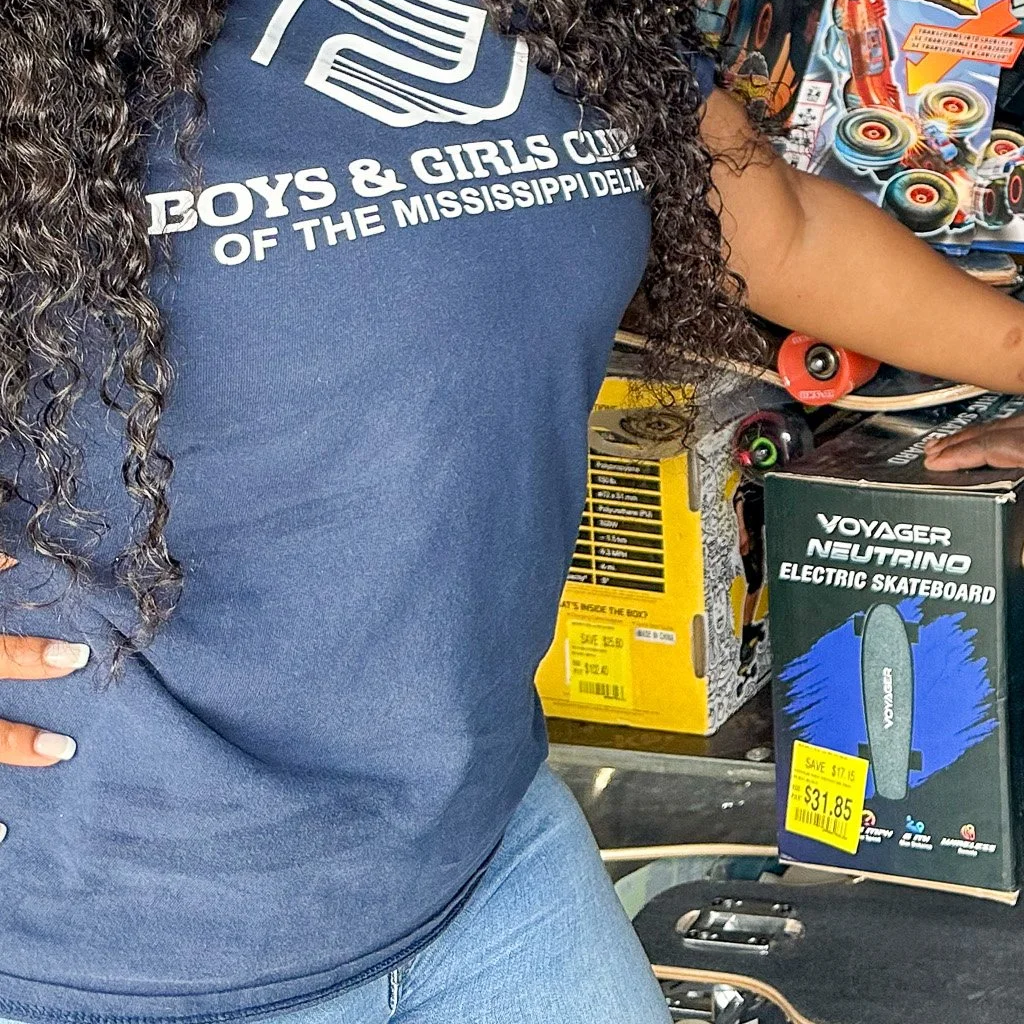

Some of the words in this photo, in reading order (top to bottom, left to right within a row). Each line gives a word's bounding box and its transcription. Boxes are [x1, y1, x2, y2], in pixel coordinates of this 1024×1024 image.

[145, 167, 338, 235] BOYS
[348, 158, 407, 198] &
[410, 134, 559, 185] GIRLS
[214, 227, 278, 266] OF
[292, 204, 386, 251] THE
[392, 173, 589, 228] MISSISSIPPI
[588, 166, 645, 197] DELTA
[816, 513, 952, 546] VOYAGER
[806, 538, 972, 575] NEUTRINO
[778, 561, 868, 591] ELECTRIC
[871, 573, 997, 605] SKATEBOARD
[609, 606, 624, 616] THE
[883, 666, 894, 730] VOYAGER
[805, 757, 826, 774] SAVE
[832, 765, 856, 782] $17.15
[804, 784, 853, 822] $31.85
